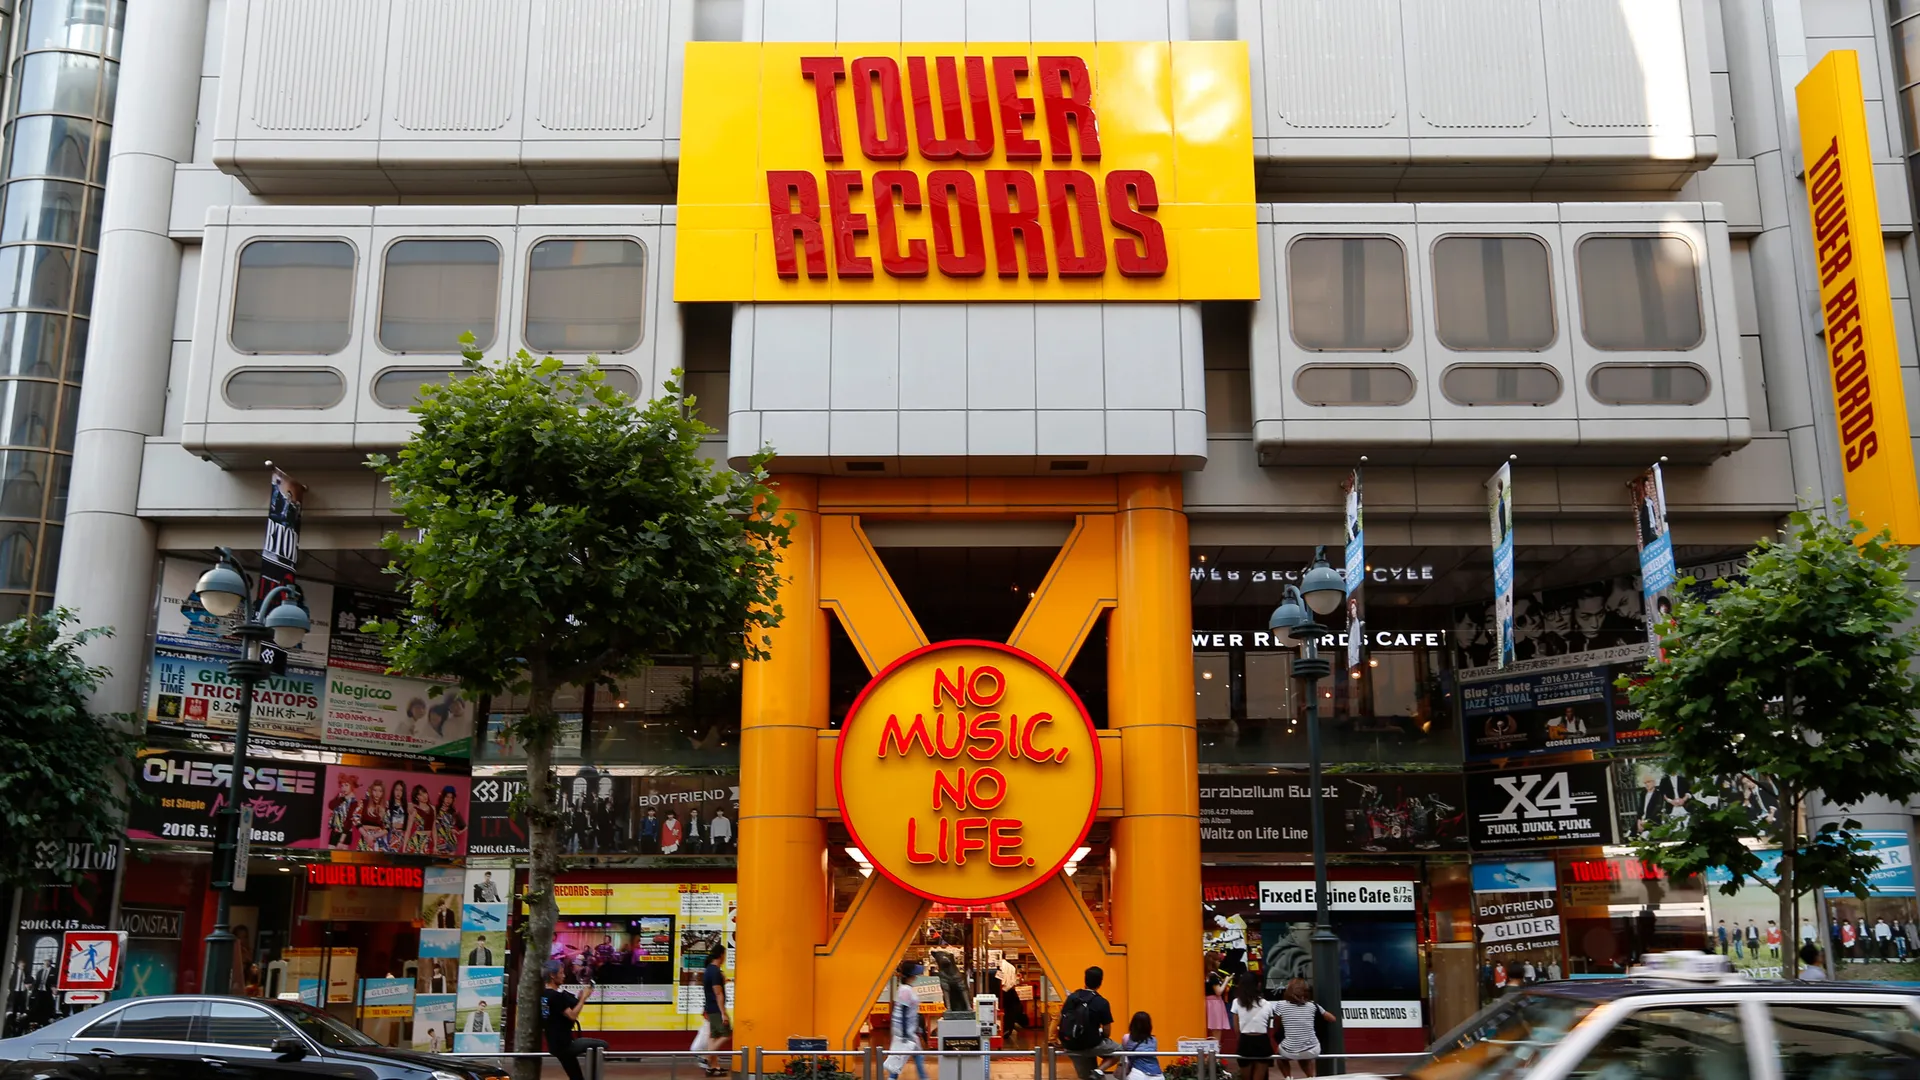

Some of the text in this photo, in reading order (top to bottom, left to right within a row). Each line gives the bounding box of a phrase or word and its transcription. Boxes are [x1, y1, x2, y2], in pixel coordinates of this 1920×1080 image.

[800, 55, 1101, 162] TOWER
[766, 169, 1168, 279] RECORDS
[1809, 135, 1878, 474] TOWER RECORDS
[1191, 633, 1244, 647] WER
[1376, 631, 1438, 647] CAFE
[160, 663, 186, 674] IN A
[160, 672, 185, 685] LIFE
[198, 669, 315, 695] GRAEVINE
[932, 665, 1007, 708] NO
[160, 682, 184, 694] TIME
[330, 680, 392, 700] Negicco
[1464, 682, 1531, 699] Blue Note
[1465, 698, 1487, 710] JAZZ
[1489, 692, 1532, 707] FESTIVAL
[256, 705, 316, 721] NHKホール
[877, 711, 1069, 764] MUSIC,
[1546, 736, 1601, 747] GEORGE BENSON
[191, 732, 210, 740] info.
[368, 750, 436, 762] www.red-hot.ne.jp
[932, 766, 1007, 811] NO
[1199, 785, 1284, 799] arabellum
[1493, 771, 1578, 820] X4
[161, 798, 175, 808] 1st
[176, 799, 206, 811] Single
[639, 789, 725, 807] BOYFRIEND
[1230, 808, 1254, 816] Release
[1211, 817, 1231, 825] Album
[1487, 818, 1592, 836] FUNK, DUNK, PUNK
[1200, 827, 1308, 840] Waltz on Life Line
[470, 844, 516, 854] 2016.6.15
[906, 817, 1035, 867] LIFE.
[307, 864, 424, 888] TOWER RECORDS
[1570, 860, 1621, 882] TOWER
[554, 885, 590, 897] RECORDS
[1204, 885, 1258, 901] RECORDS
[1261, 886, 1391, 906] Fixed Egine Cafe
[1393, 895, 1412, 903] 6/26
[1479, 898, 1554, 917] BOYFRIEND
[20, 919, 79, 930] 2016.6.15
[119, 913, 178, 934] MONSTA X
[1495, 919, 1556, 938] GLIDER
[1486, 940, 1559, 954] 2016.6.1 RELEASE
[468, 978, 494, 987] GLIDER
[917, 985, 940, 993] GLIDE
[371, 987, 400, 996] GLIDER
[1341, 1007, 1407, 1020] TOWER RECORDS
